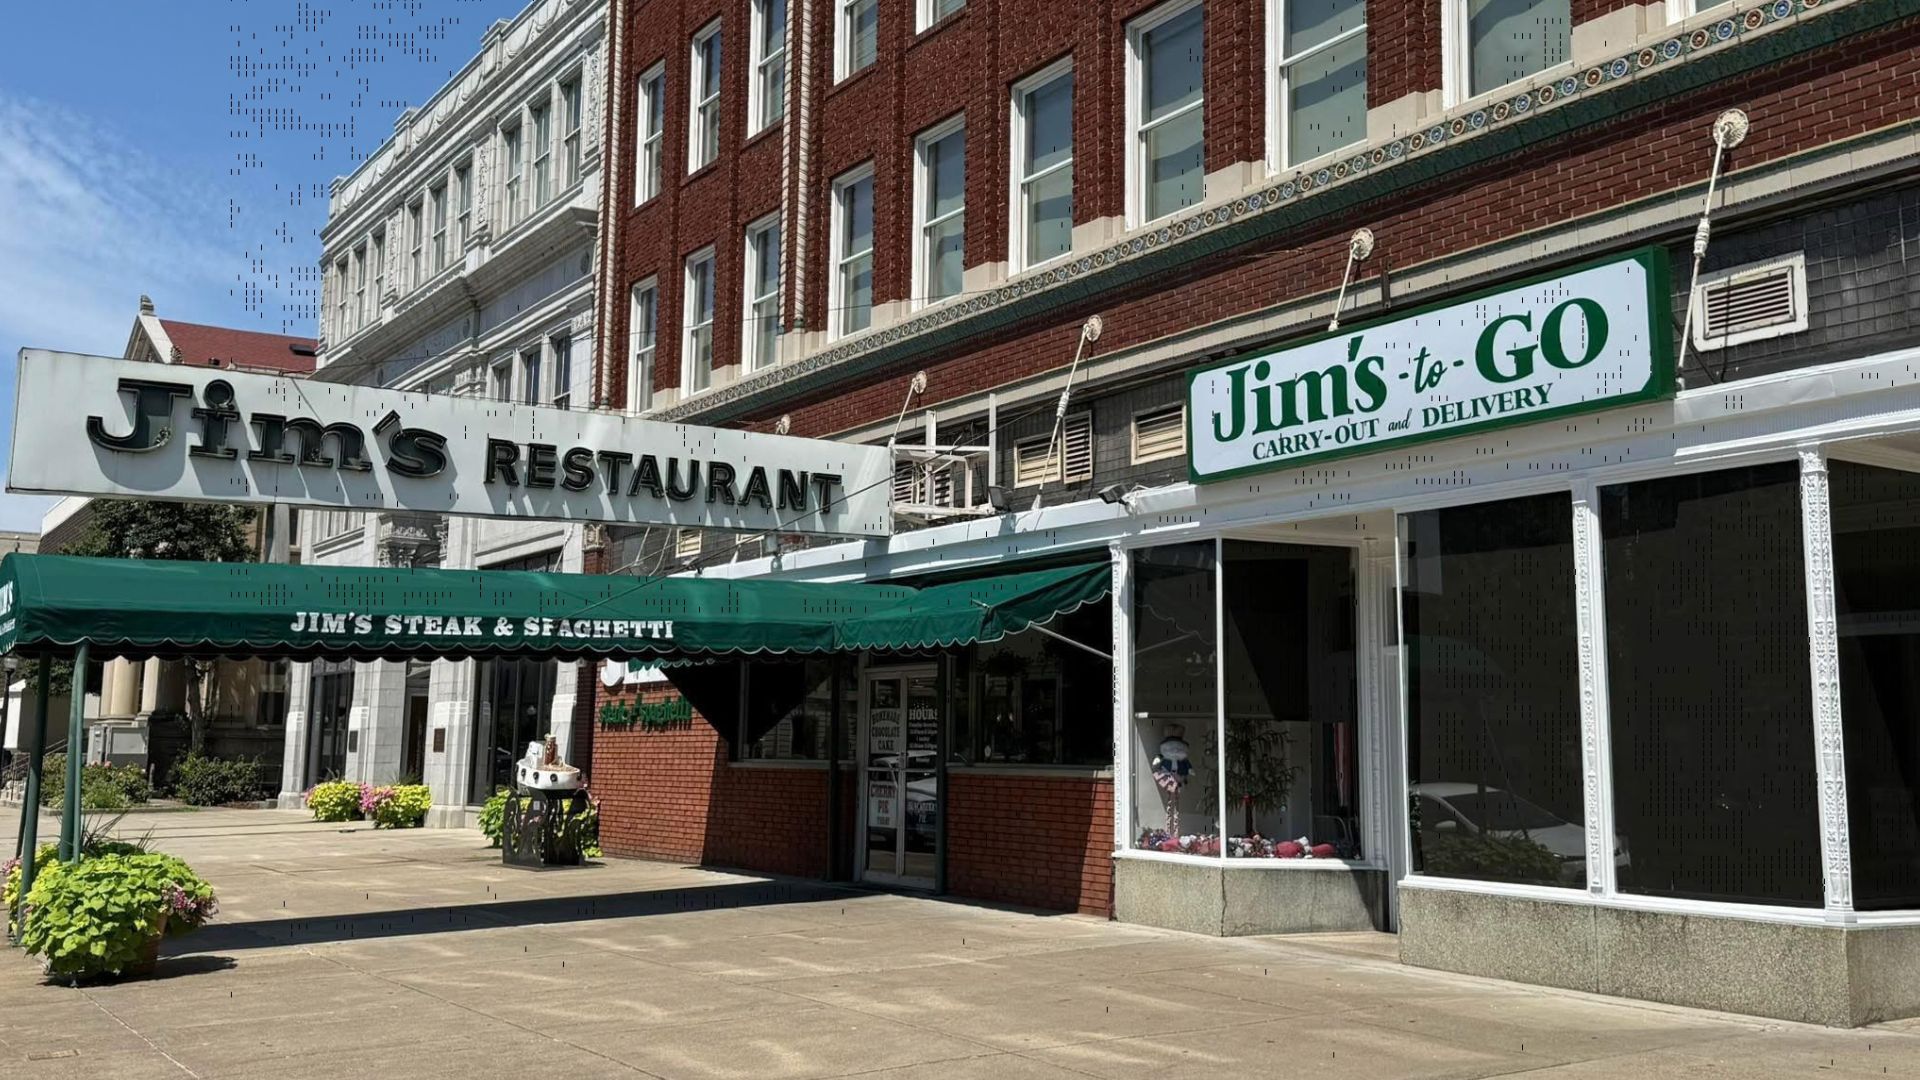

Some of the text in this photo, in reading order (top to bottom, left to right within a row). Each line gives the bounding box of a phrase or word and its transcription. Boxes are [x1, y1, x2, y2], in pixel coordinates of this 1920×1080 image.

[1213, 335, 1387, 443] Jim's
[1475, 297, 1610, 384] GO
[86, 378, 842, 514] Jim's RESTAURANT
[1252, 383, 1554, 460] CARRY-OUT and DELIVERY
[290, 611, 674, 639] JIM'S STEAK & SPAGHETTI
[878, 740, 894, 751] CAKE
